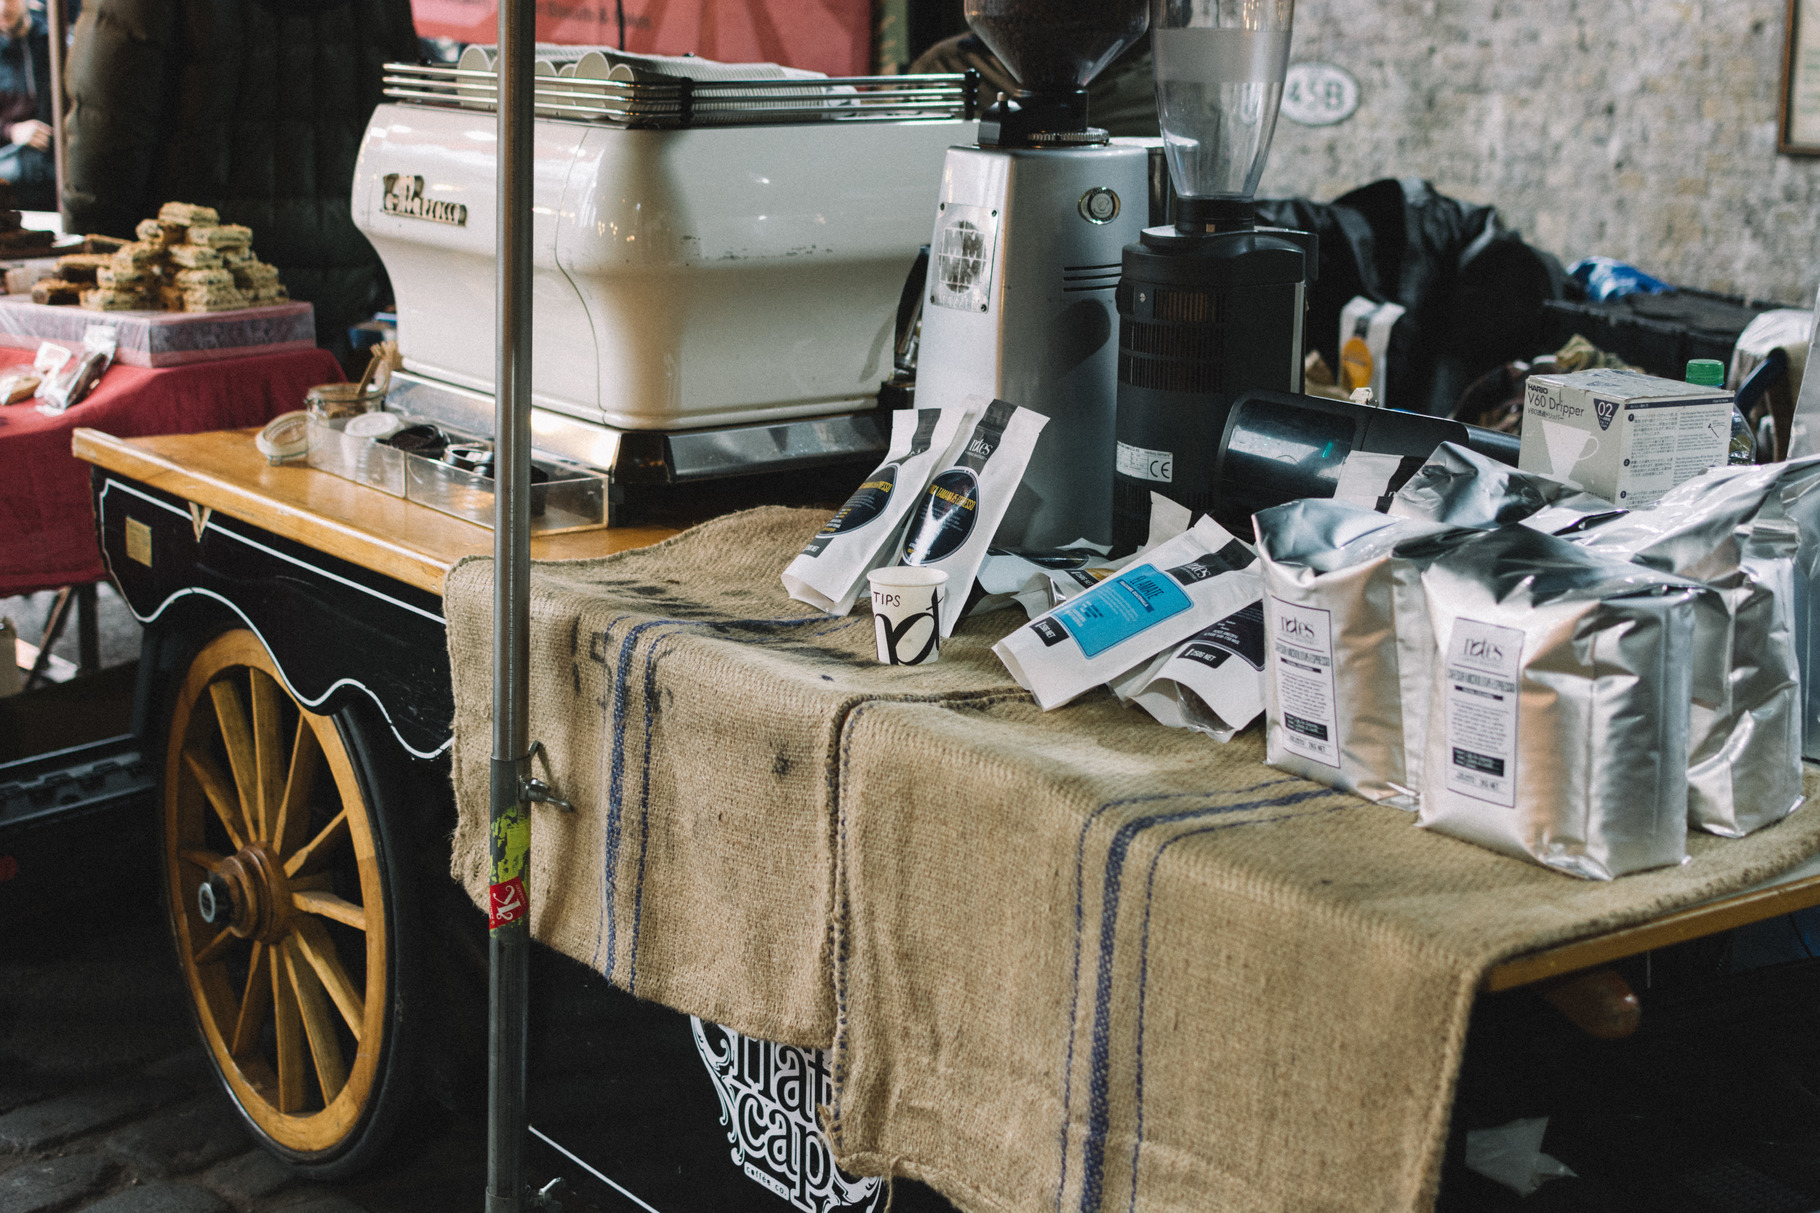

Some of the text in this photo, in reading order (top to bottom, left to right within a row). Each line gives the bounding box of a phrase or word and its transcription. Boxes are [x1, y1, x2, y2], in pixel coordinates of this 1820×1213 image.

[1528, 384, 1548, 395] HARIO
[1528, 391, 1585, 418] V60 Dripper
[1597, 402, 1613, 418] 02
[1150, 460, 1171, 479] CE
[1135, 579, 1164, 600] AMATE
[873, 591, 901, 608] TIPS
[1202, 652, 1217, 662] NET
[774, 1184, 787, 1196] co.
